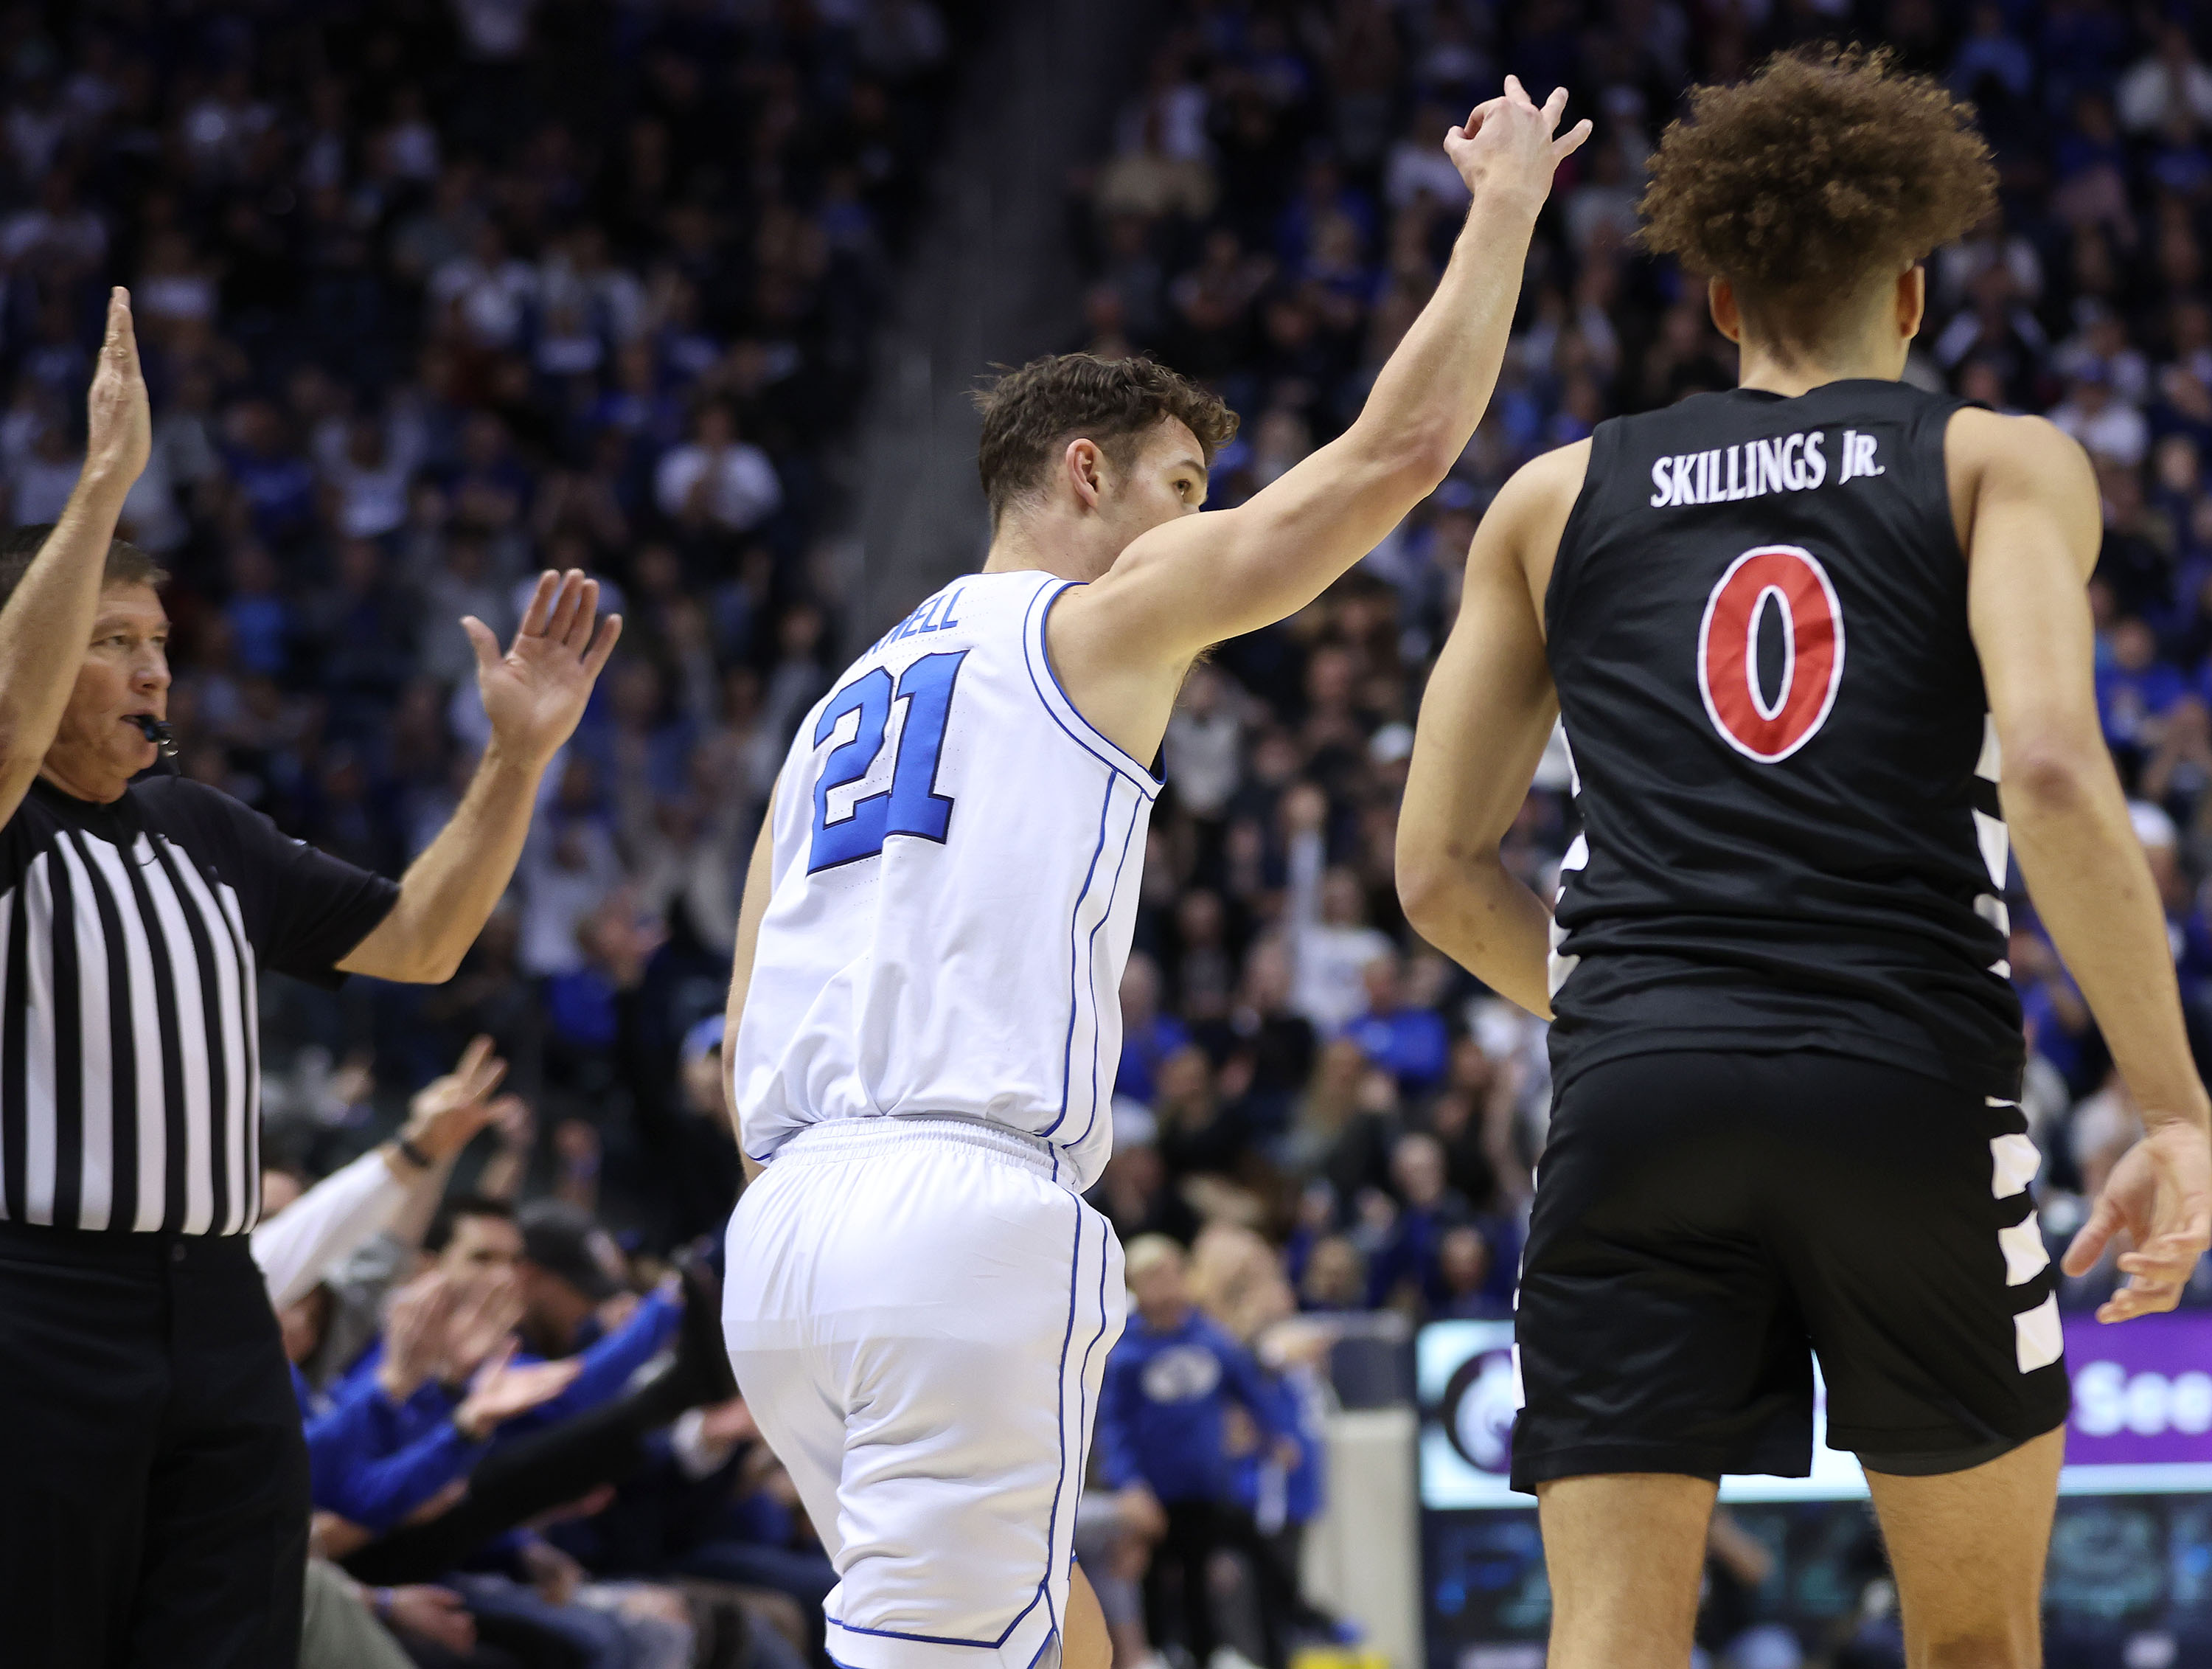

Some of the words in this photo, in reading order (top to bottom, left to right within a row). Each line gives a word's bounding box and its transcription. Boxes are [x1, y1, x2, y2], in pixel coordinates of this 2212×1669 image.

[1650, 431, 1827, 507] SKILLINGS
[1839, 429, 1885, 485] JR.
[807, 649, 970, 877] 21
[1697, 544, 1846, 763] 0
